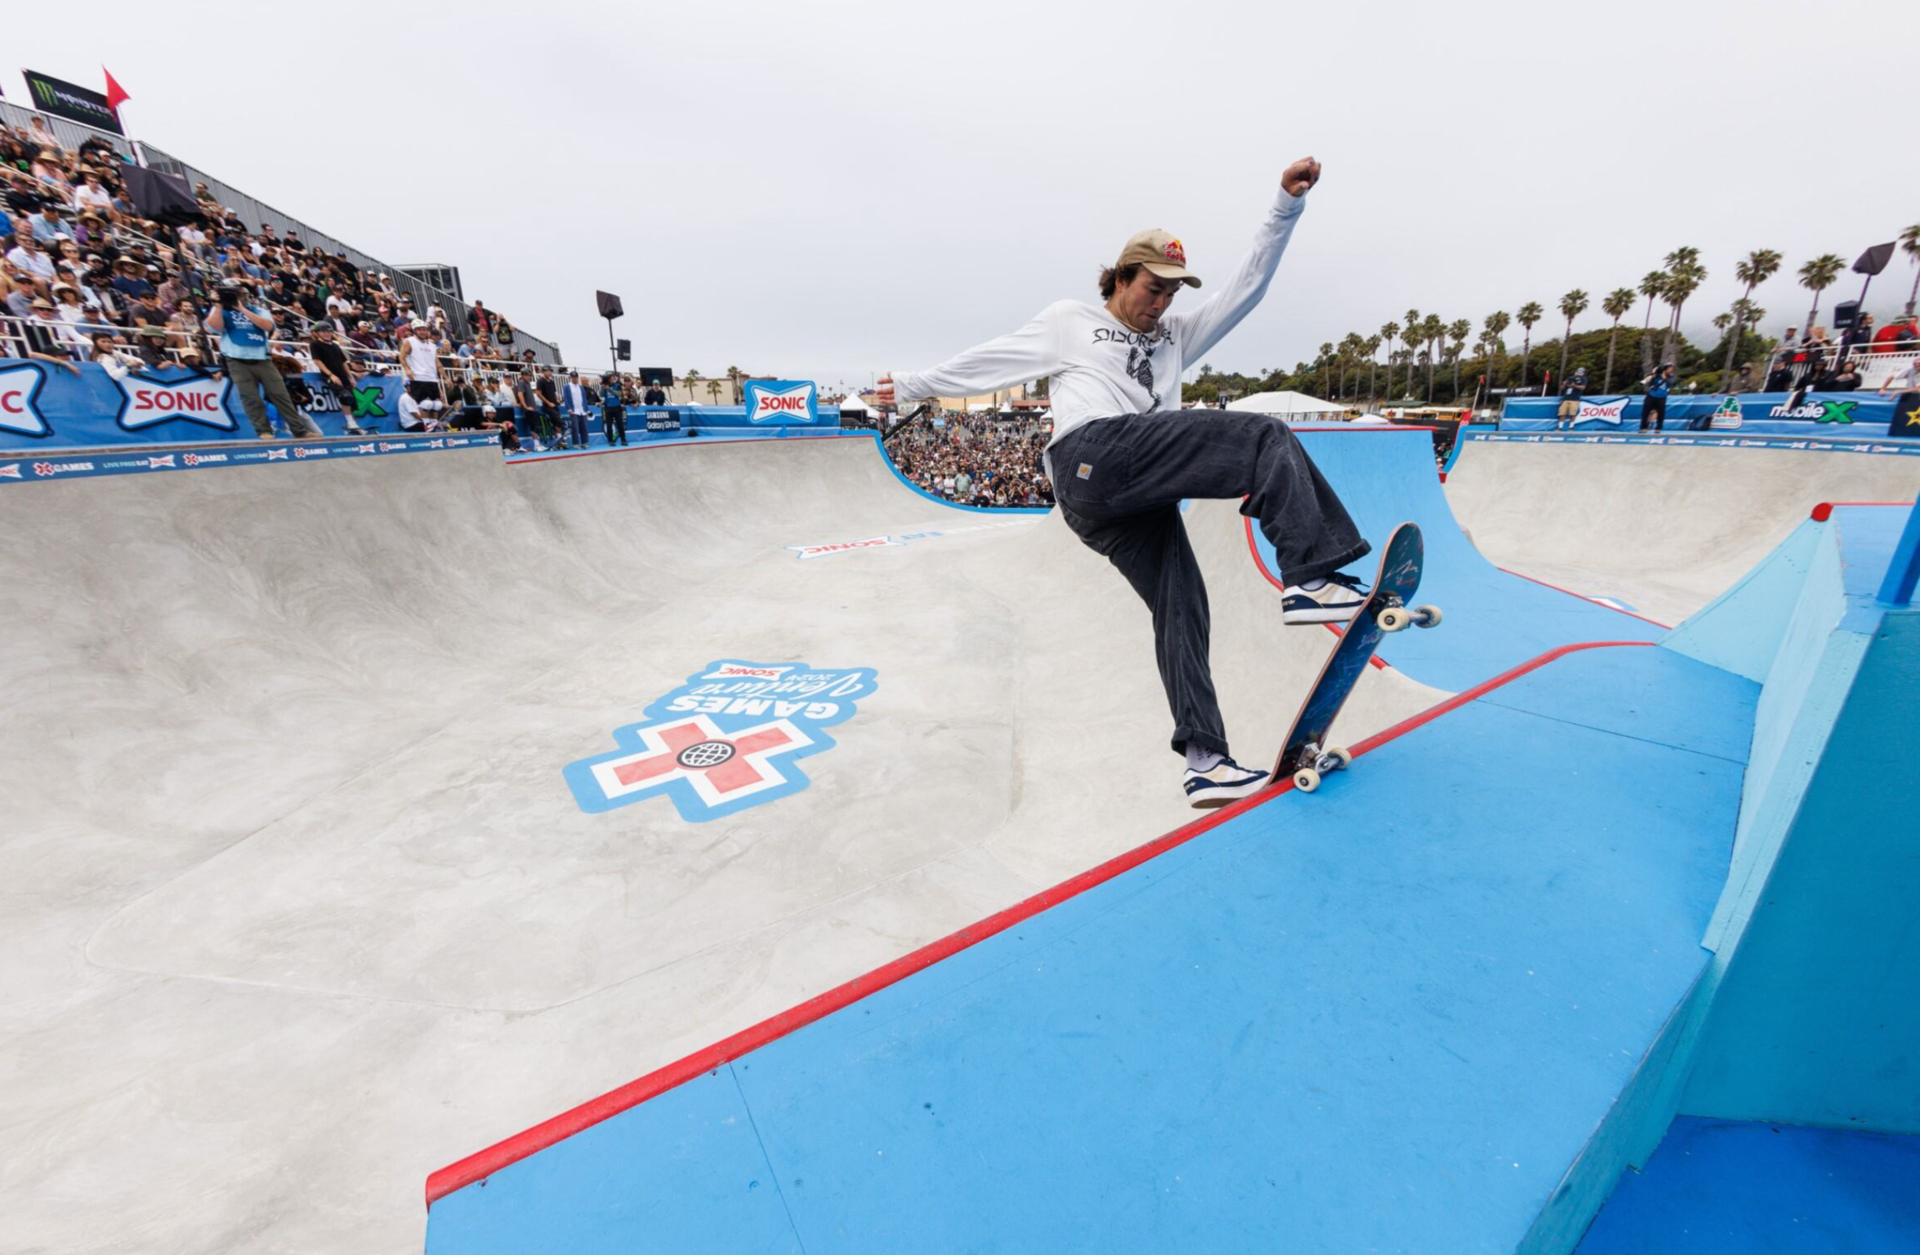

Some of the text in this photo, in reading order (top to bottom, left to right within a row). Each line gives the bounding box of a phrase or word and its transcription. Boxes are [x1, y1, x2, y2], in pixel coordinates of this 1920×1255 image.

[135, 390, 218, 411] SONIC
[759, 397, 805, 410] SONIC
[1580, 407, 1619, 417] SONIC
[198, 454, 228, 462] GAMES
[53, 462, 94, 473] GAMES
[804, 540, 887, 553] SONIC
[719, 667, 781, 677] SONIC
[689, 673, 864, 700] Ventura
[664, 695, 840, 720] GAMES
